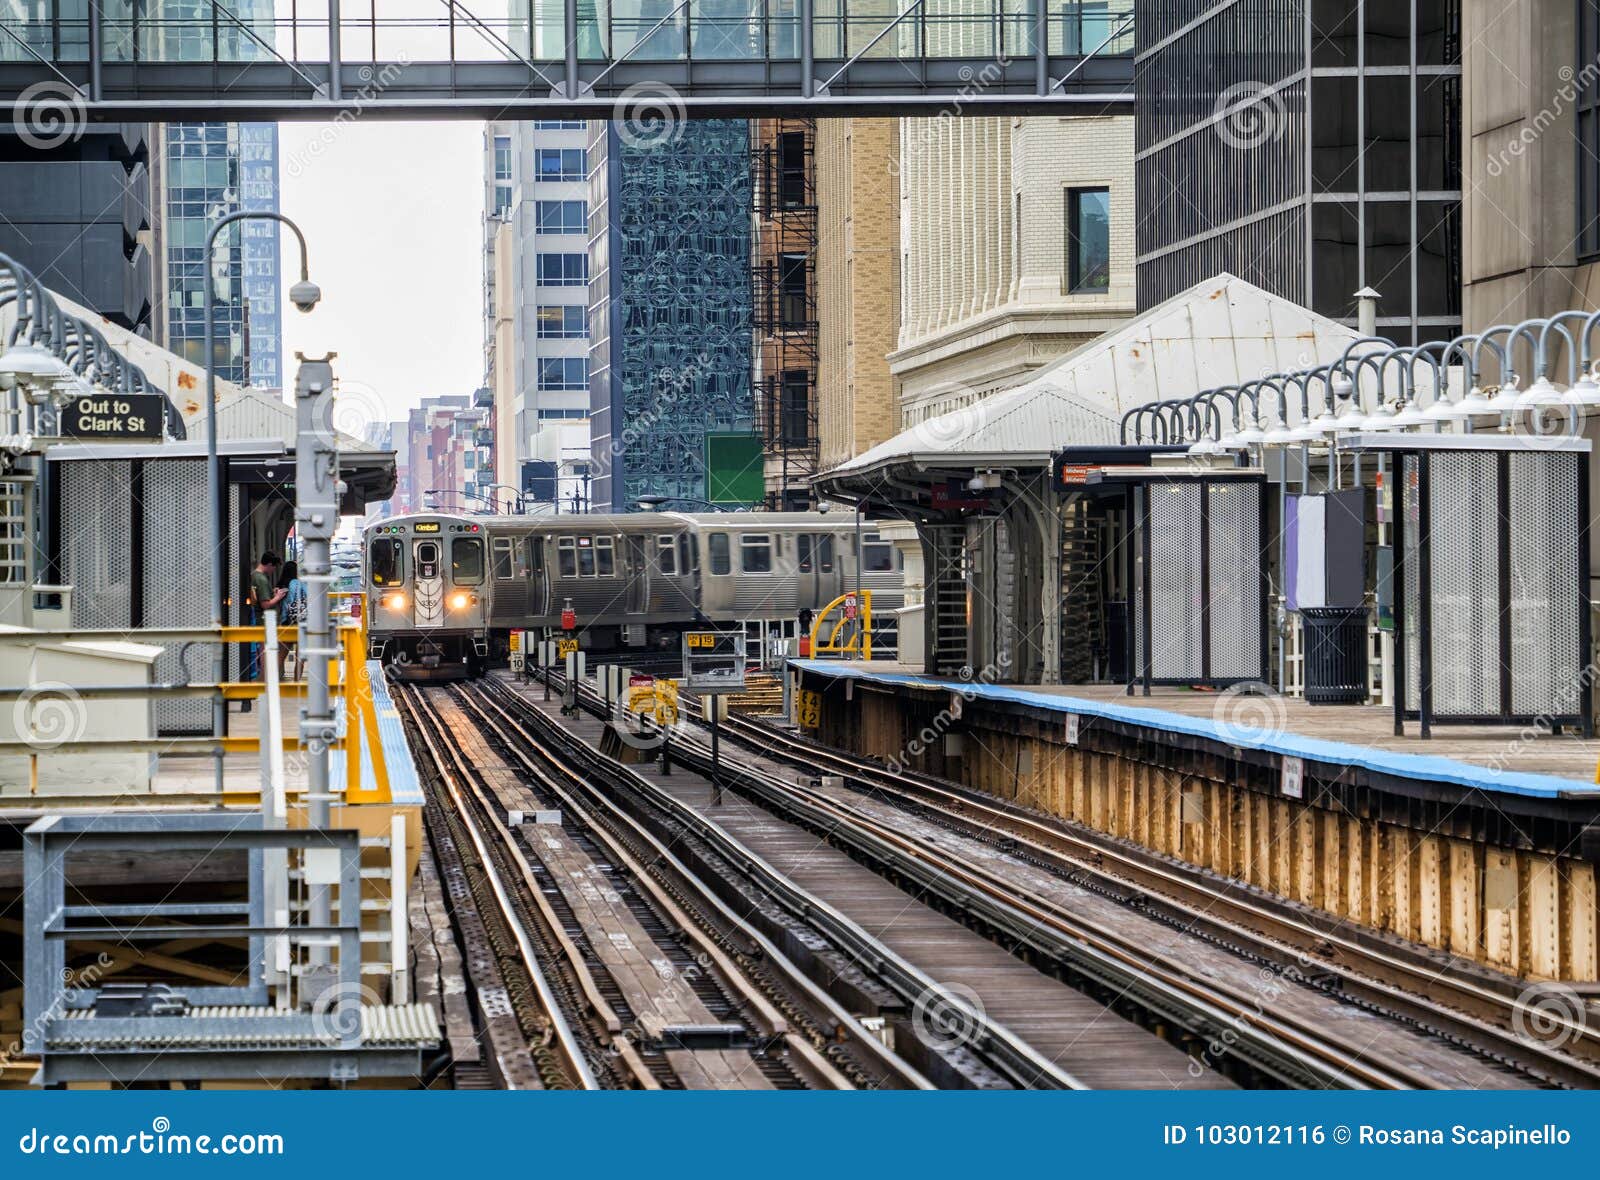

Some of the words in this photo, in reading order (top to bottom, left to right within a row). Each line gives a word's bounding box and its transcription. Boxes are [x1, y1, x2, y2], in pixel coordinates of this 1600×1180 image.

[79, 399, 109, 414] Out
[113, 400, 130, 414] to
[78, 416, 122, 431] Clark
[127, 416, 145, 431] St
[512, 660, 523, 668] 10
[810, 695, 818, 707] 4
[809, 712, 817, 725] 2
